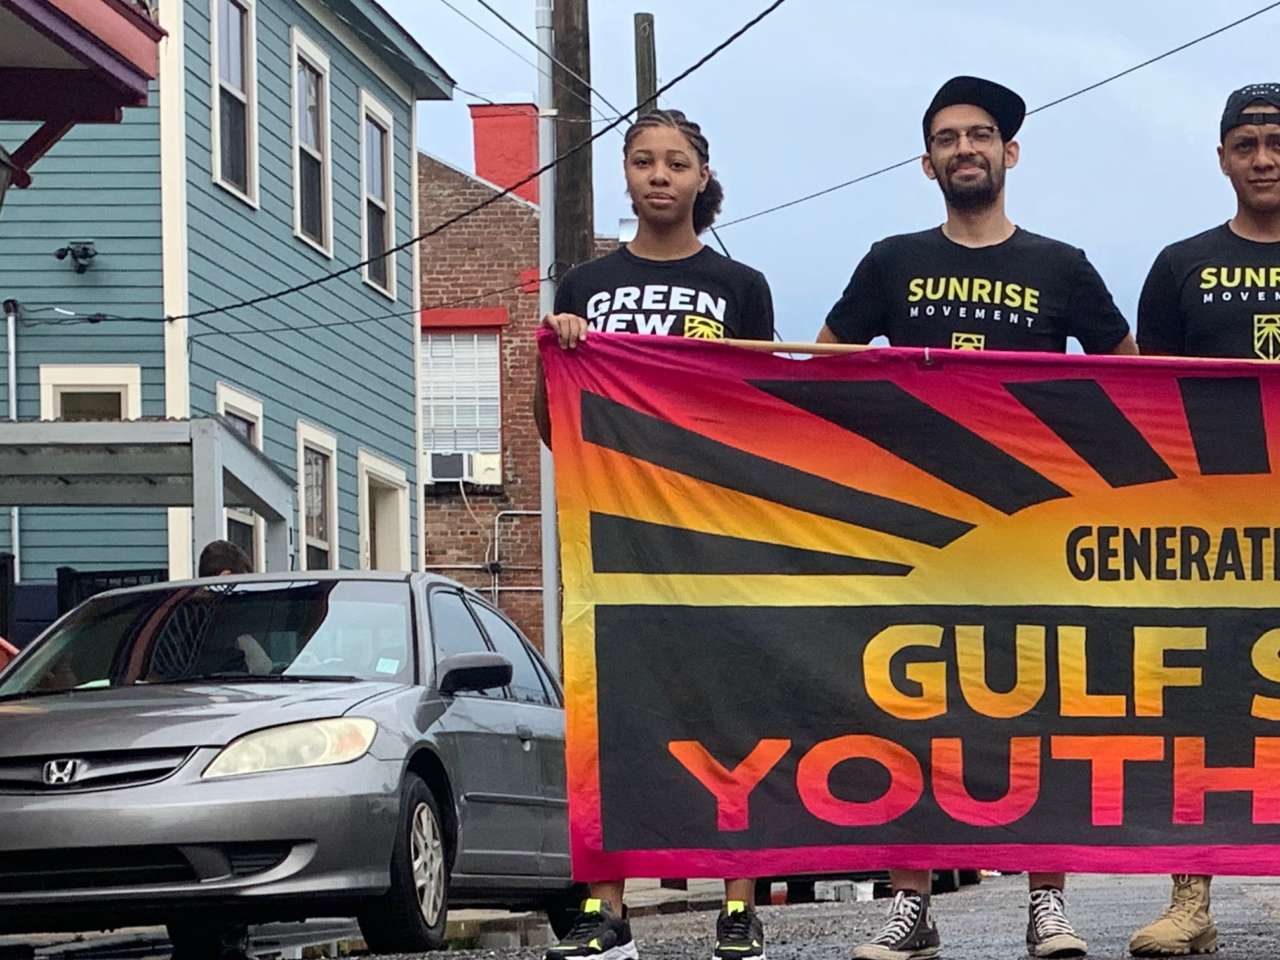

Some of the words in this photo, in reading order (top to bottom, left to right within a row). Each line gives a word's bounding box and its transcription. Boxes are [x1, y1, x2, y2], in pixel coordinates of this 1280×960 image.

[586, 285, 727, 322] GREEN
[908, 277, 1040, 314] SUNRISE
[910, 305, 1034, 328] MOVEMENT
[862, 624, 1207, 721] GULF
